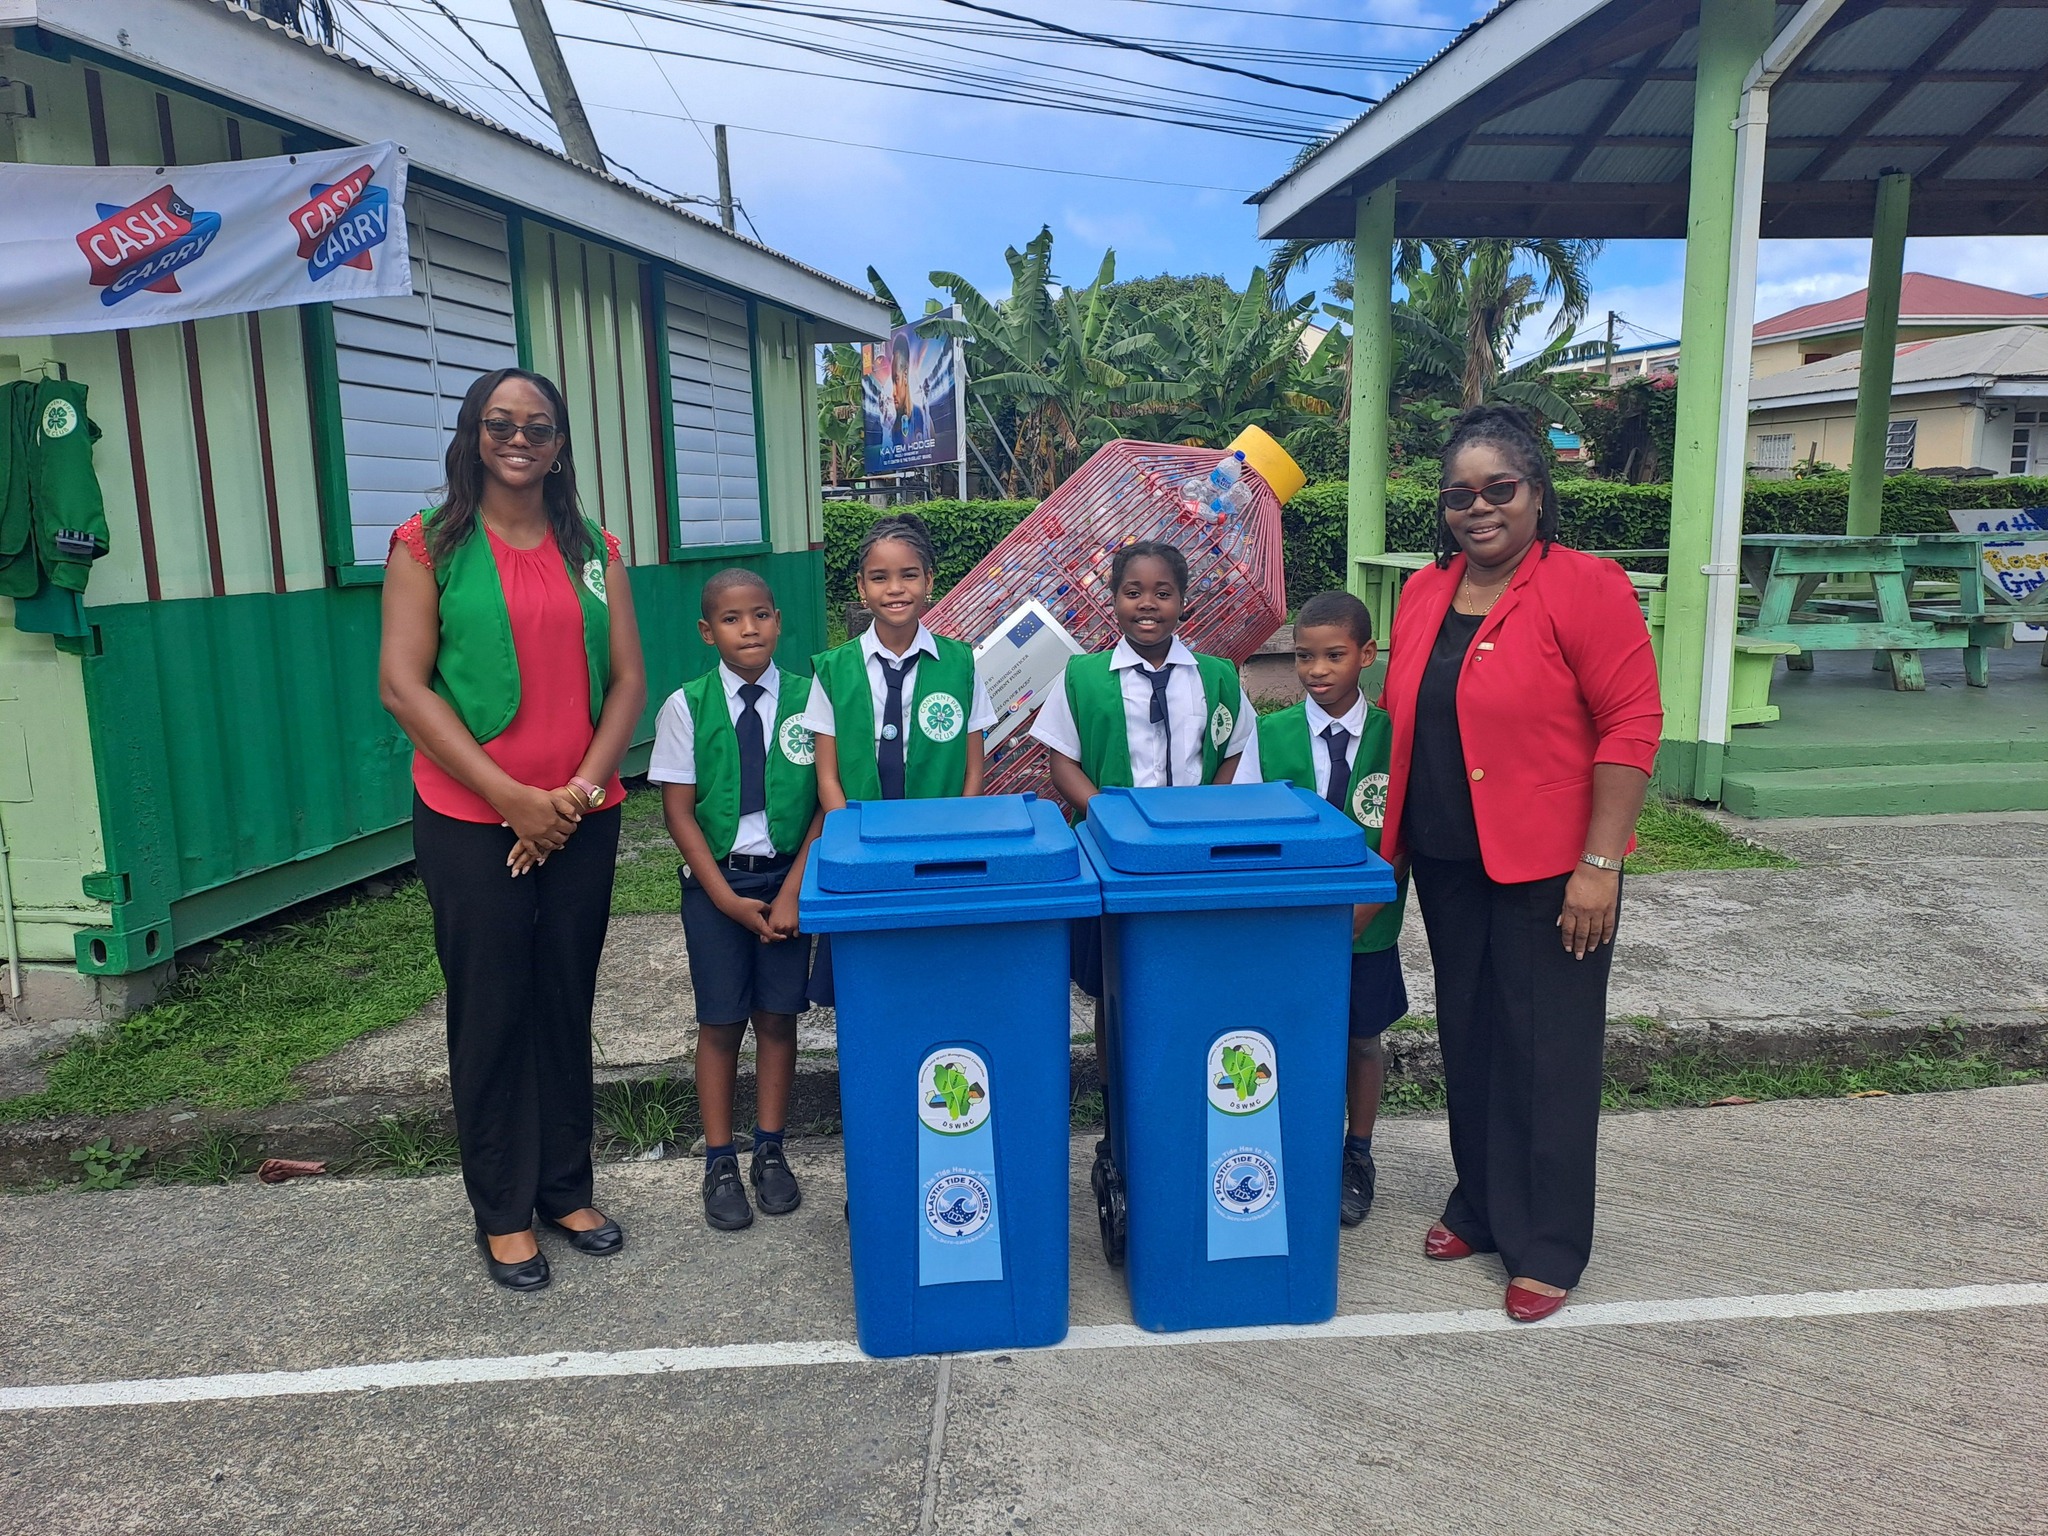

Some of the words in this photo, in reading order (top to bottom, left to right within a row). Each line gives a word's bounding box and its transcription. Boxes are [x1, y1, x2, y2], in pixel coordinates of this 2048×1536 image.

[301, 178, 363, 240] CASH
[89, 203, 178, 266] CASH
[172, 201, 189, 217] &
[313, 204, 388, 270] CARRY
[112, 231, 213, 292] CARRY
[908, 438, 936, 451] HODGE
[1009, 669, 1022, 681] FUND
[920, 694, 950, 714] CONVENT
[951, 700, 962, 719] PREP
[780, 714, 804, 738] CONVE
[935, 730, 955, 741] CLUB
[799, 755, 815, 764] CLU
[1229, 1099, 1262, 1110] DSWMC
[942, 1118, 975, 1130] DSWMC
[1211, 1157, 1223, 1168] The
[1222, 1148, 1238, 1158] Tide
[1264, 1150, 1277, 1164] Turn
[922, 1178, 935, 1189] The
[934, 1168, 951, 1178] Tide
[968, 1168, 976, 1176] to
[976, 1171, 991, 1186] Turn
[1216, 1162, 1232, 1195] PLASTIC
[1232, 1156, 1252, 1164] TIDE
[1255, 1158, 1275, 1191] TURNERS
[928, 1183, 945, 1217] PLASTIC
[945, 1177, 966, 1185] TIDE
[968, 1179, 989, 1214] TURNERS
